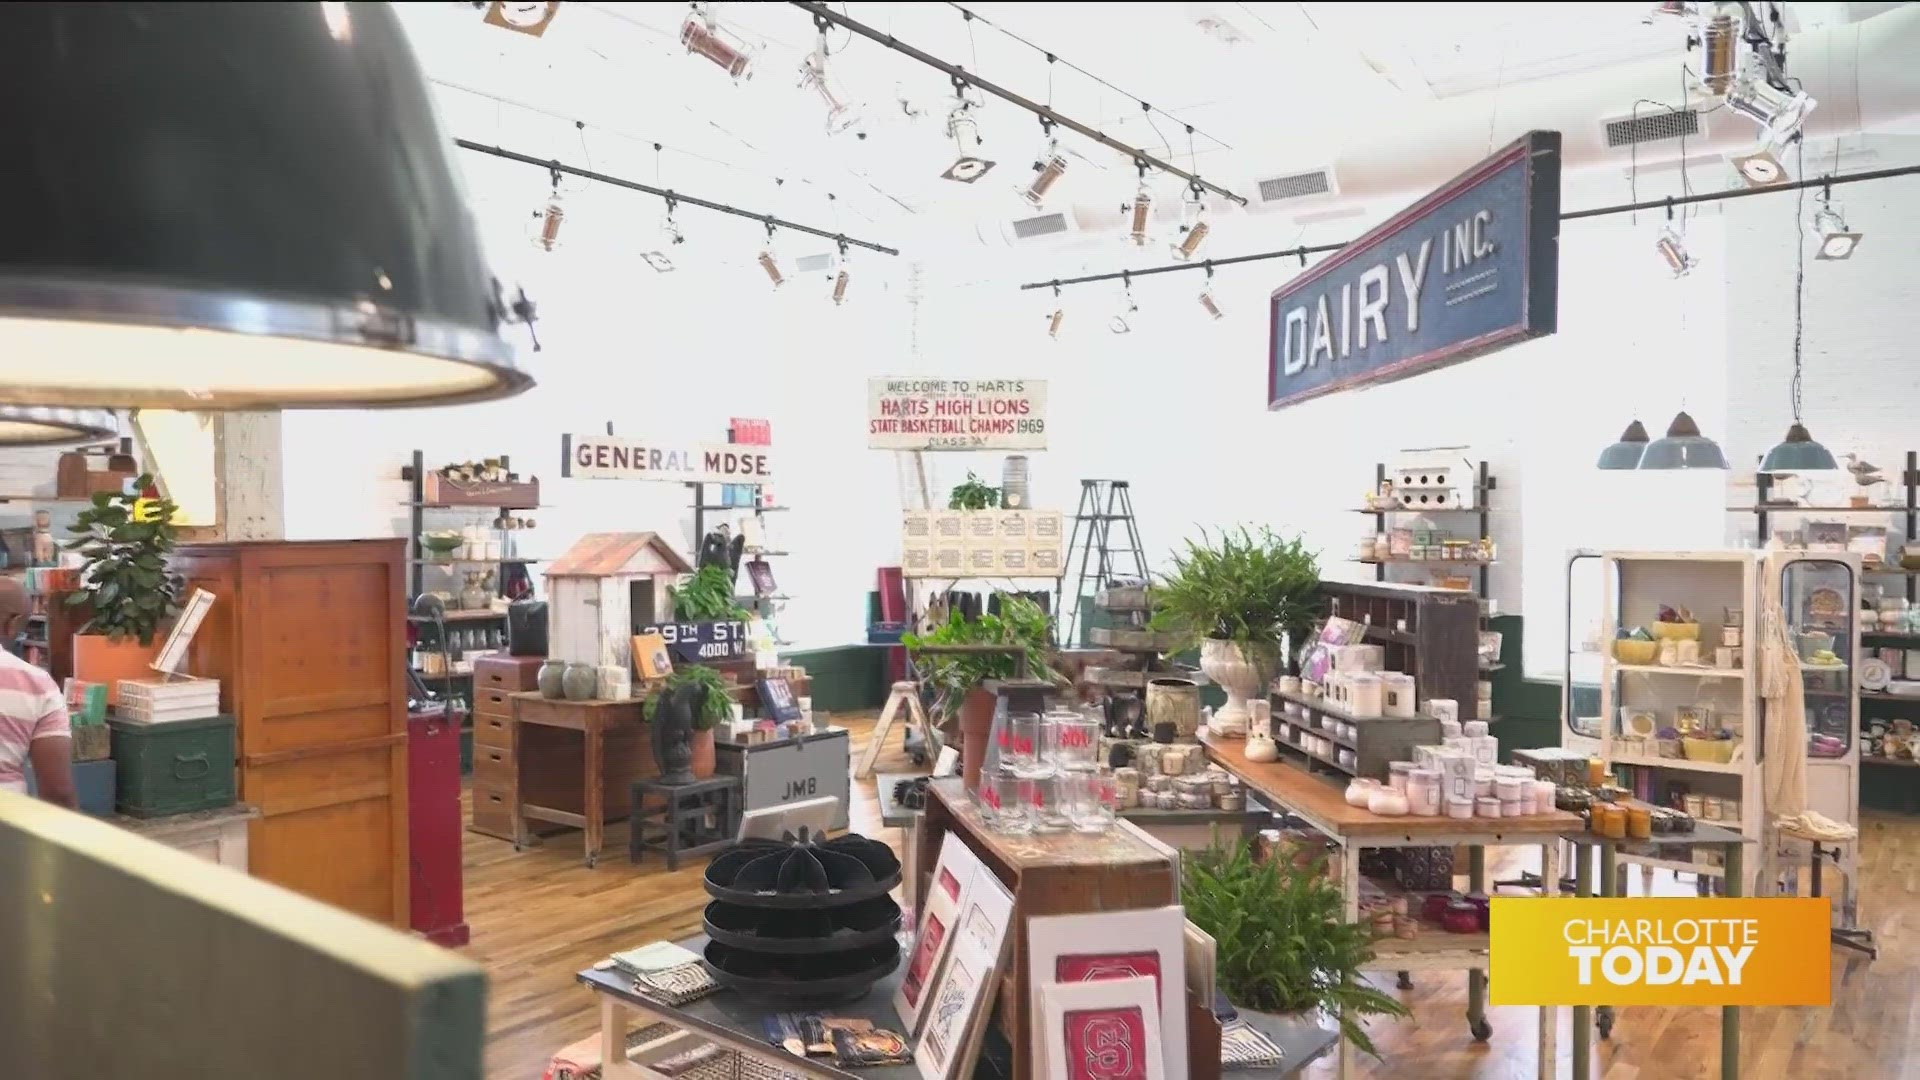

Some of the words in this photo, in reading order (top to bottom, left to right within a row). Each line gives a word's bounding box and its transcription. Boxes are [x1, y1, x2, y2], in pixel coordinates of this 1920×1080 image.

[1284, 236, 1434, 376] DAIRY
[1442, 208, 1495, 274] INC.
[887, 381, 948, 393] WELCOME
[952, 381, 969, 393] TO
[976, 381, 1025, 392] HARTS
[881, 400, 929, 416] HARTS
[935, 400, 972, 415] HIGH
[978, 400, 1030, 415] LIONS
[870, 419, 898, 434] STATE
[901, 419, 965, 434] BASKETBALL
[969, 419, 1015, 434] CHAMPS
[1016, 419, 1044, 434] 1969
[928, 437, 967, 447] CLASS
[577, 443, 695, 472] GENERAL
[705, 451, 771, 476] MDSE.
[698, 642, 729, 658] 4000
[781, 777, 816, 800] JMB
